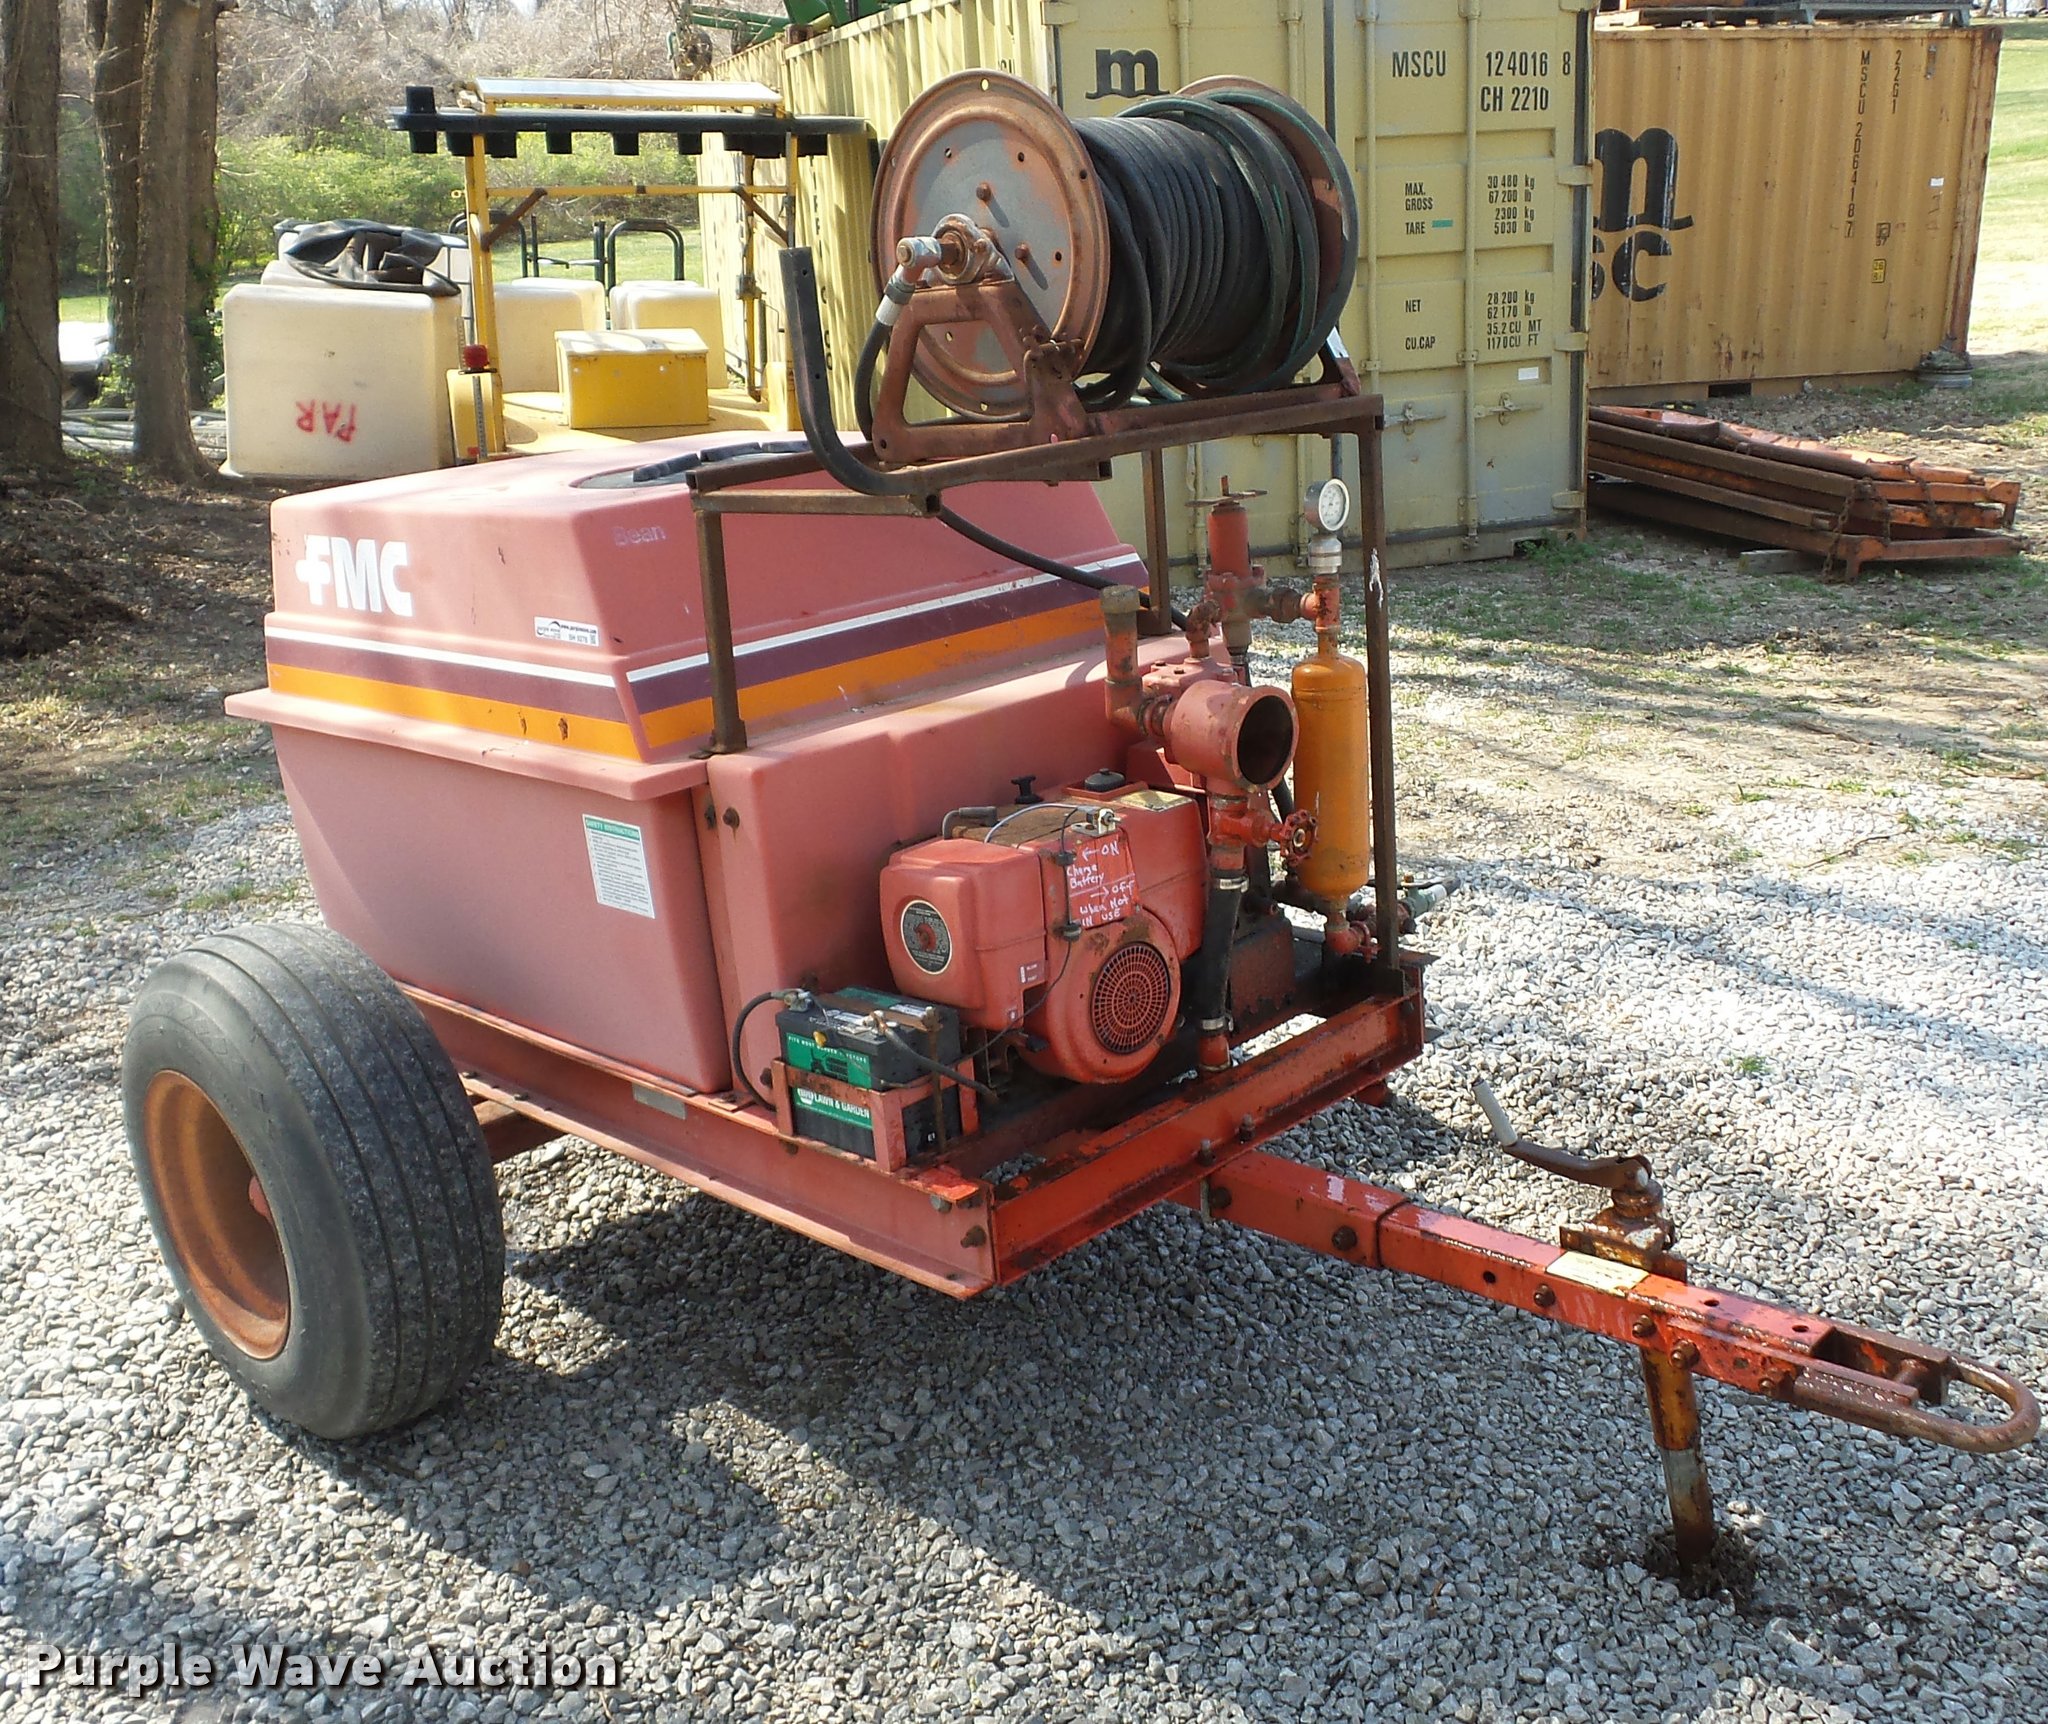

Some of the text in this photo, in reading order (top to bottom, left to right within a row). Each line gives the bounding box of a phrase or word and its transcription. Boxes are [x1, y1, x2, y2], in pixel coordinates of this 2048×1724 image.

[1392, 50, 1571, 77] MSCU 124016 8
[1858, 50, 1870, 115] MSCU
[1480, 86, 1549, 112] CH 2210
[1524, 173, 1535, 190] kg
[1405, 182, 1426, 196] MAX.
[1524, 189, 1532, 202] lb
[1405, 197, 1433, 211] GROSS
[1524, 205, 1535, 221] kg
[1405, 221, 1426, 235] TARE
[1523, 220, 1532, 233] lb
[1524, 289, 1535, 305] kg
[1405, 299, 1421, 313] NET
[1524, 303, 1532, 316] lb
[1528, 319, 1542, 333] MT
[1527, 333, 1538, 347] FT
[295, 534, 414, 617] FMC
[1101, 841, 1120, 857] ON
